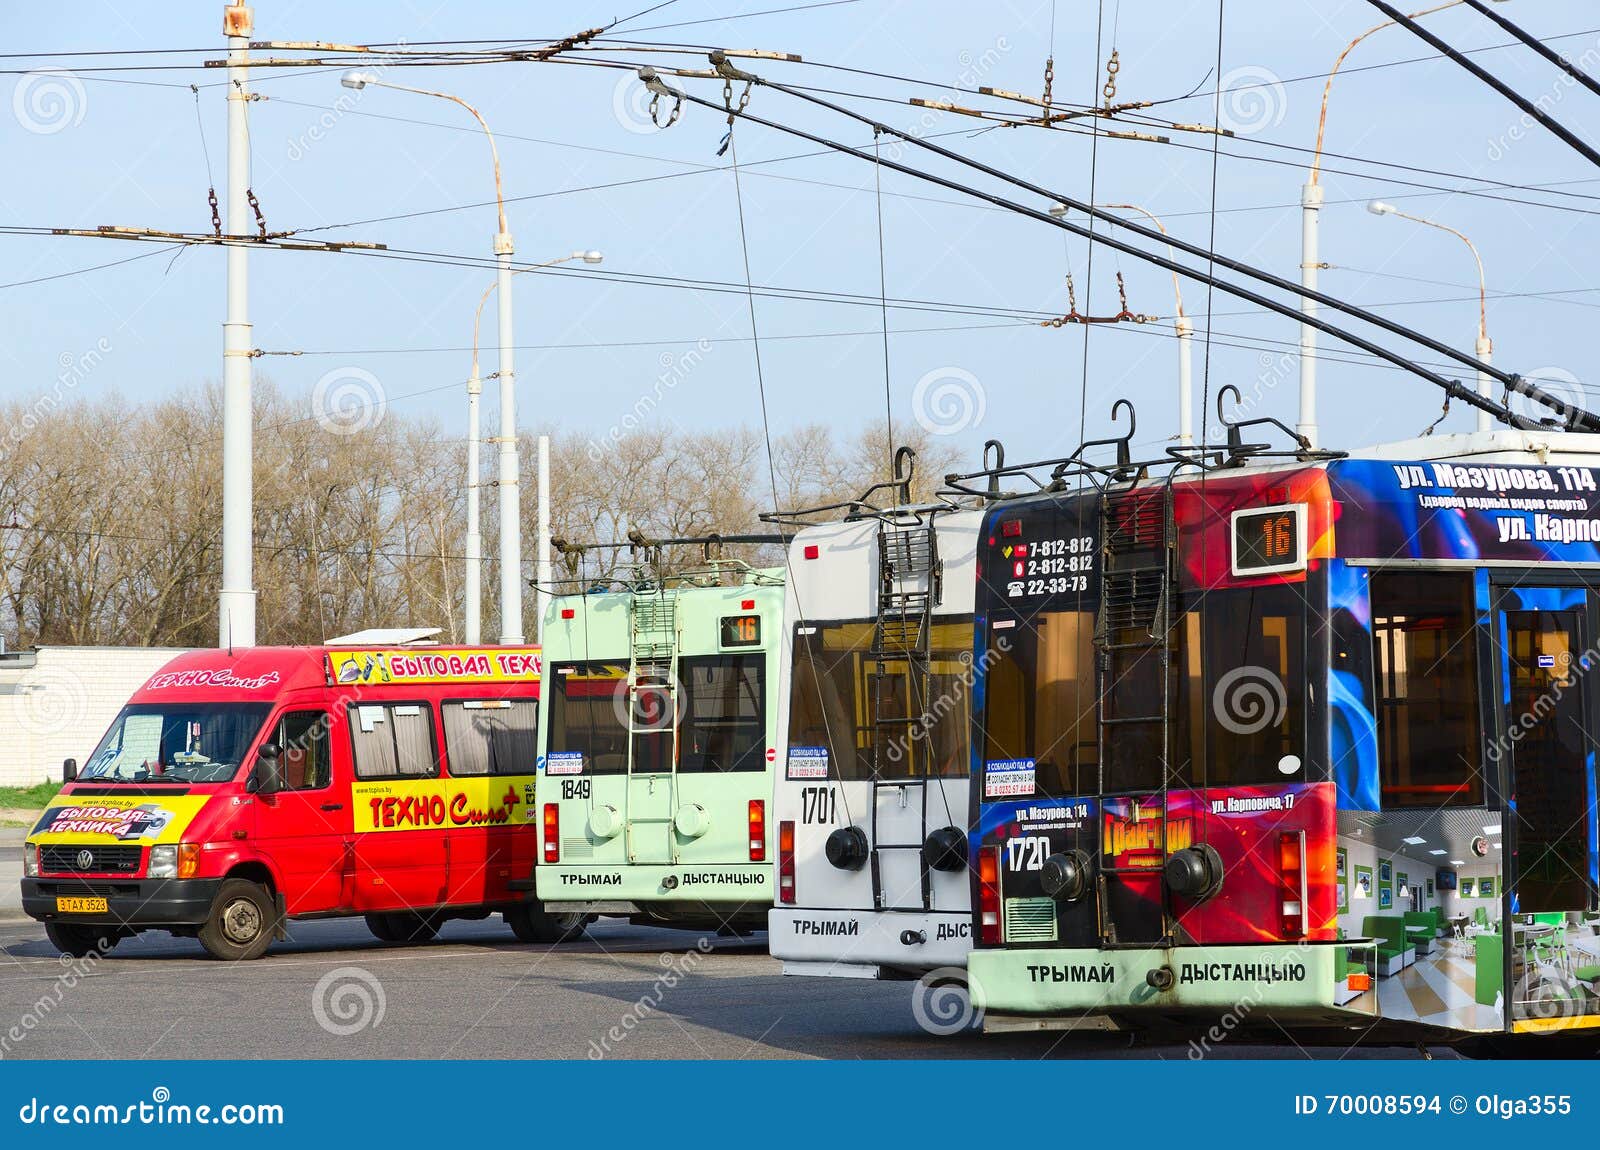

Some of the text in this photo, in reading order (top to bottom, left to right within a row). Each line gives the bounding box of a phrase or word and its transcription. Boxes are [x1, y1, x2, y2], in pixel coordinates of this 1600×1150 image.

[1393, 463, 1597, 493] ул. Мазурова, 114
[1418, 494, 1588, 511] (дворец водных видов спорта)
[1264, 517, 1290, 557] 16
[1497, 513, 1600, 544] ул. Карпо
[1029, 537, 1093, 558] 7-812-812
[1028, 555, 1093, 576] 2-812-812
[1027, 575, 1088, 596] 22-33-73
[737, 618, 756, 641] 16
[391, 655, 491, 676] БЫТОВАЯ
[561, 779, 591, 800] 1849
[55, 806, 144, 822] БЫТОВАЯ
[370, 795, 445, 827] ТЕХНО
[801, 787, 836, 824] 1701
[1016, 809, 1029, 822] ул.
[1030, 807, 1073, 820] Мазурова,
[1212, 794, 1294, 814] ул. Карповича, 17
[48, 820, 132, 836] ТЕХНИКА
[1006, 836, 1050, 872] 1720
[560, 872, 765, 886] ТРЫМАЙ ДЫСТАНЦЫЮ
[793, 919, 859, 936] ТРЫМАЙ
[1027, 962, 1306, 985] ТРЫМАЙ ДЫСТАНЦЫЮ
